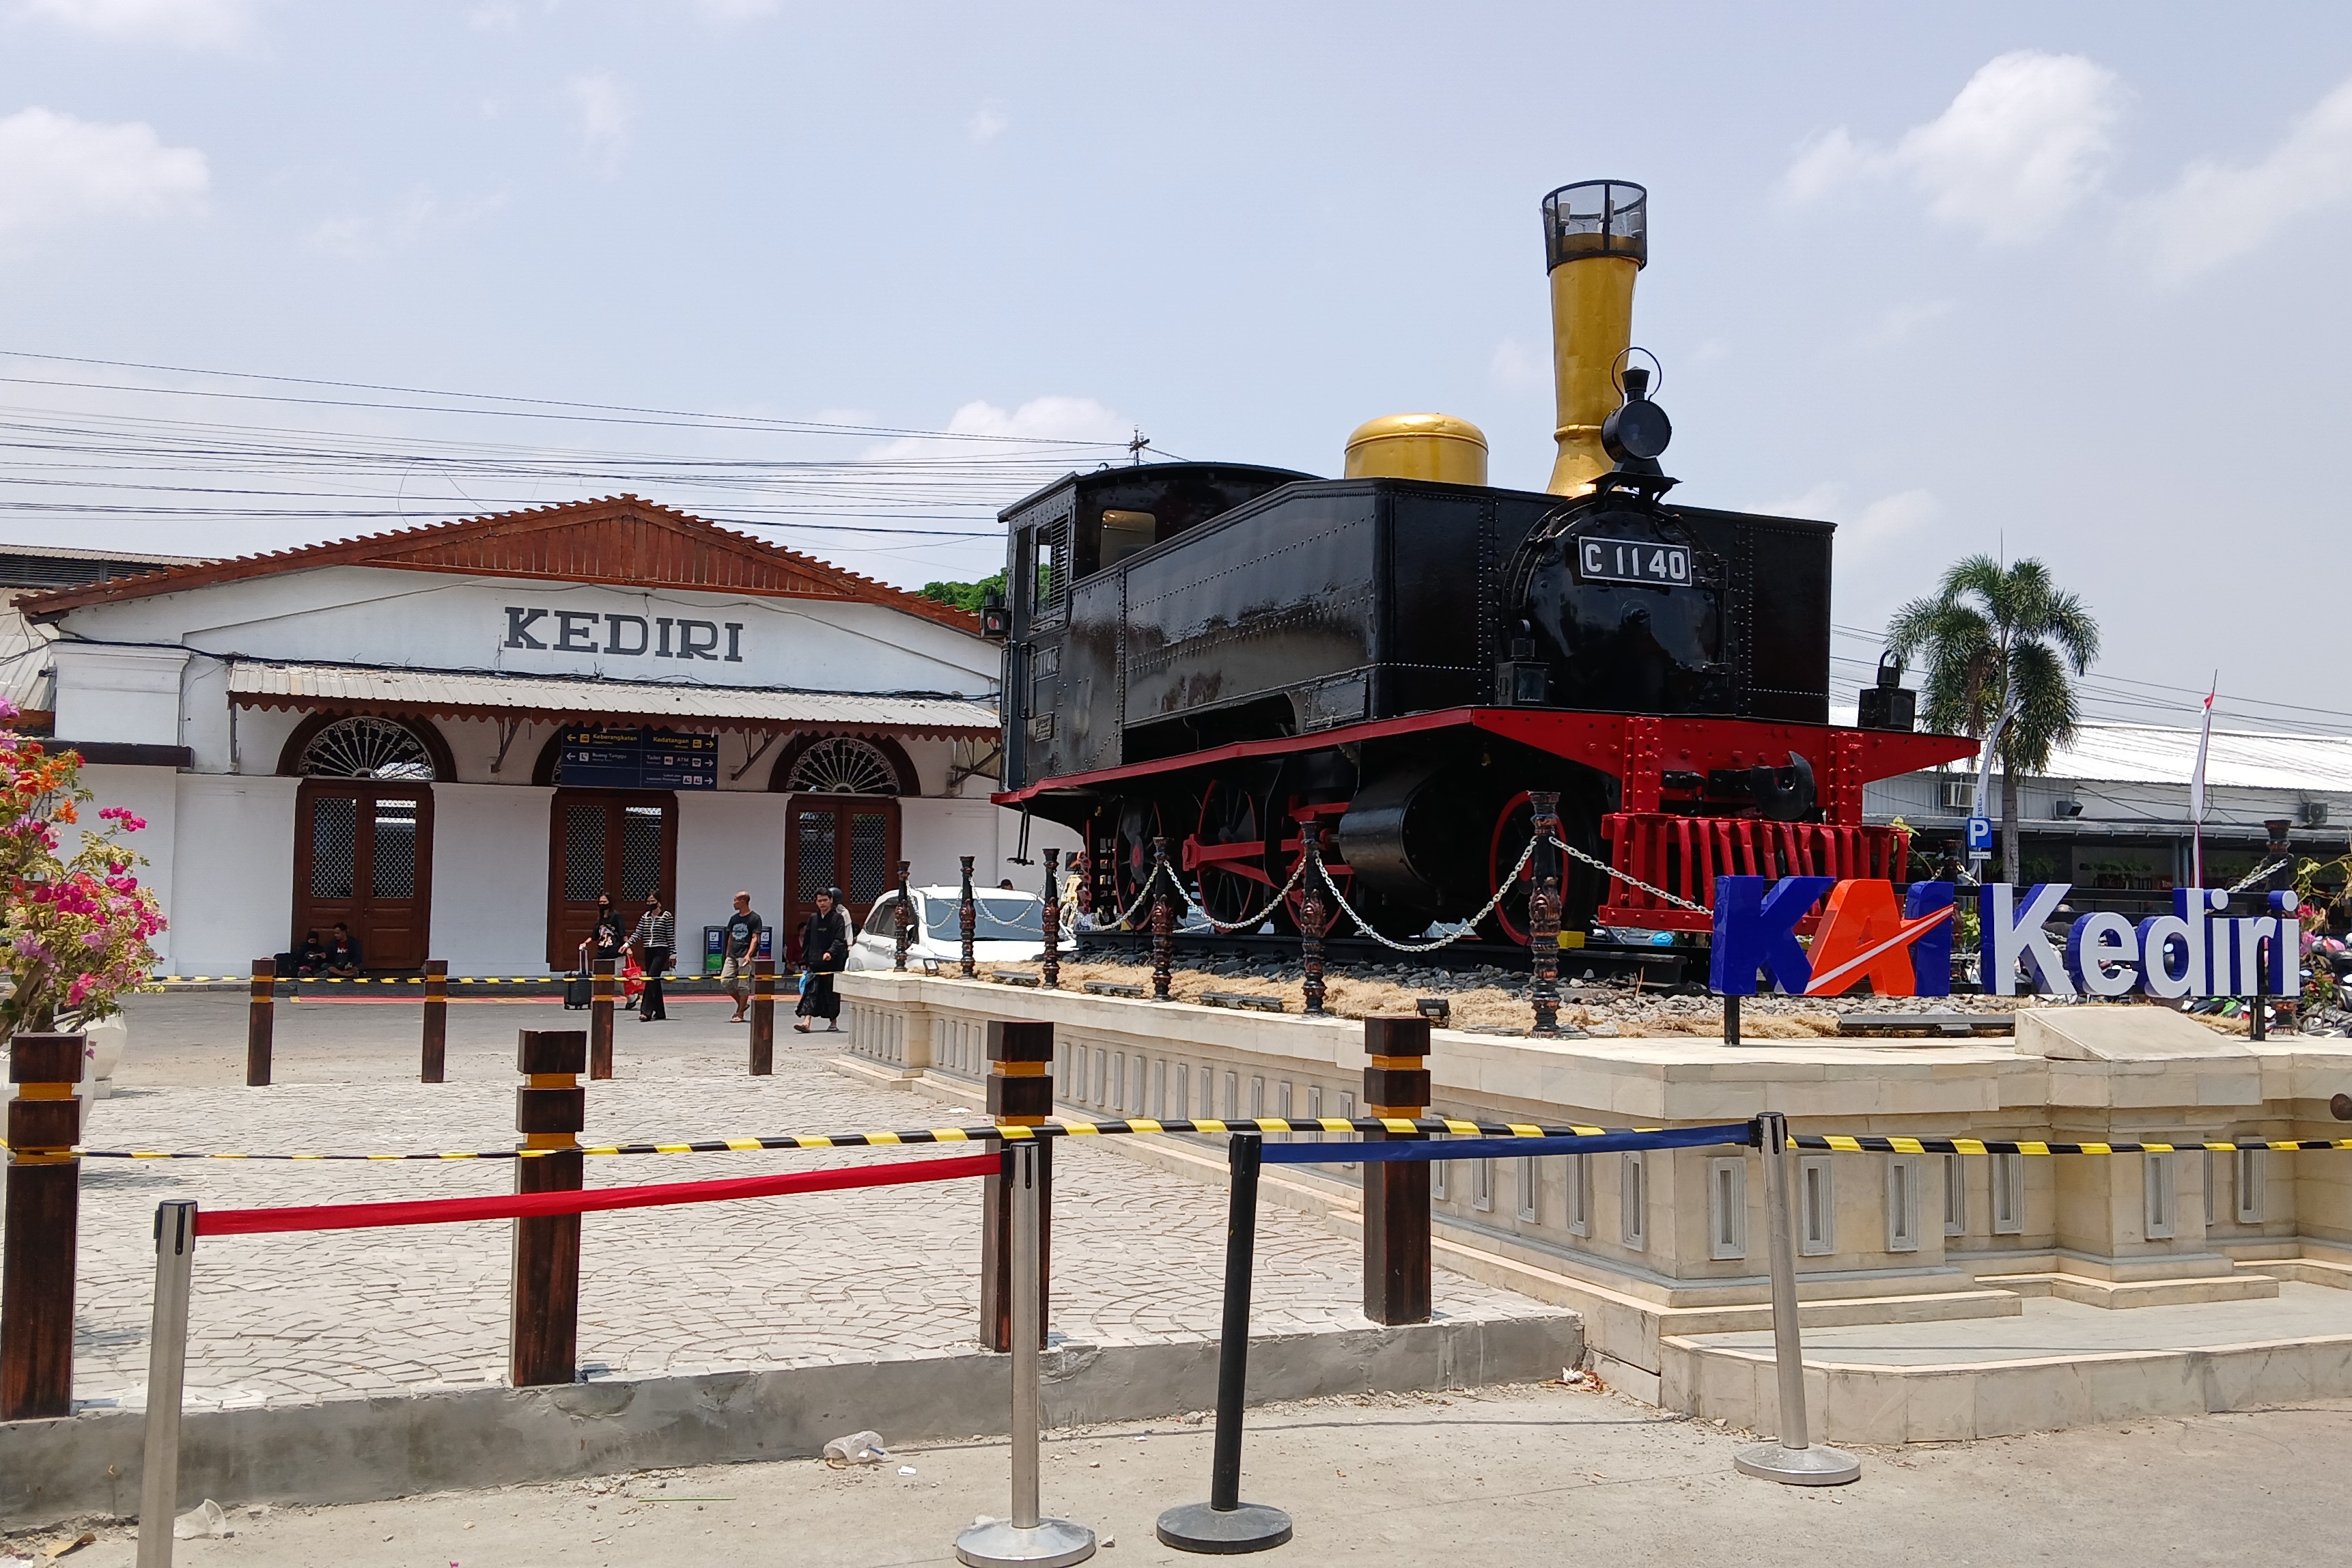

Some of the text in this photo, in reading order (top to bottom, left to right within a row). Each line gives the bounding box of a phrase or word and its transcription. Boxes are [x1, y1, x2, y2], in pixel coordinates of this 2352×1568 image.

[1585, 544, 1602, 572] C
[504, 606, 744, 662] KEDIRI
[593, 733, 637, 742] Keberangkatan
[653, 736, 689, 744] Kedatangan
[1970, 820, 1989, 846] P
[1709, 876, 2300, 998] KAI Kediri
